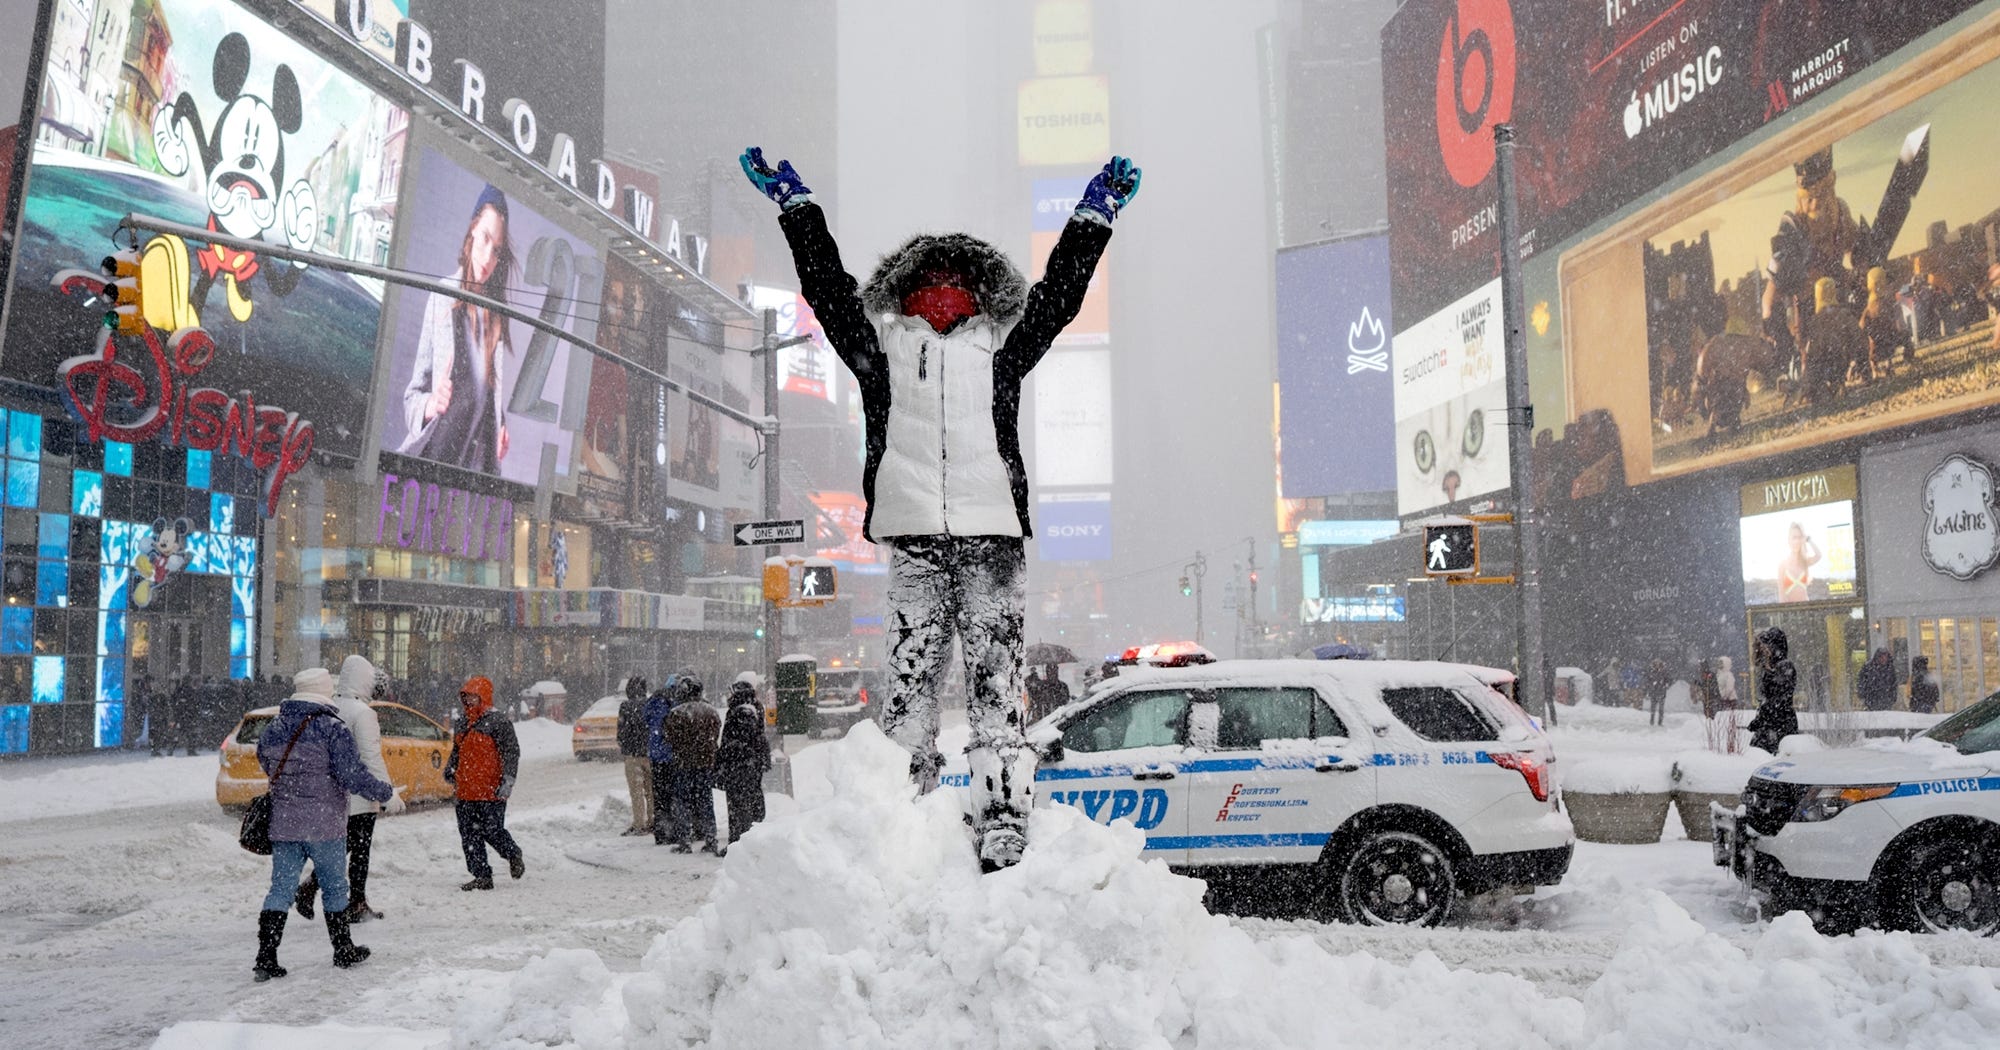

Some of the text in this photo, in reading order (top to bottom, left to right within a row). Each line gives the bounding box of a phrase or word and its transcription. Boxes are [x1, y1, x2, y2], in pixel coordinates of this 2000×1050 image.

[1639, 20, 1699, 73] LISTEN ON
[1792, 38, 1850, 84] MARRIOTT
[1645, 45, 1723, 128] MUSIC
[1793, 60, 1844, 100] MARQUIS
[1024, 112, 1105, 129] TOSHIBA
[402, 20, 707, 275] BROADWAY
[1452, 202, 1498, 250] PRESEN
[1461, 297, 1492, 328] ALWAYS
[1462, 320, 1486, 345] WANT
[1403, 350, 1440, 385] swatch
[1763, 474, 1830, 508] INVICTA
[376, 472, 513, 561] FOREVER
[754, 527, 796, 539] ONE WAY
[1048, 525, 1103, 537] SONY
[1922, 779, 1979, 795] POLICE
